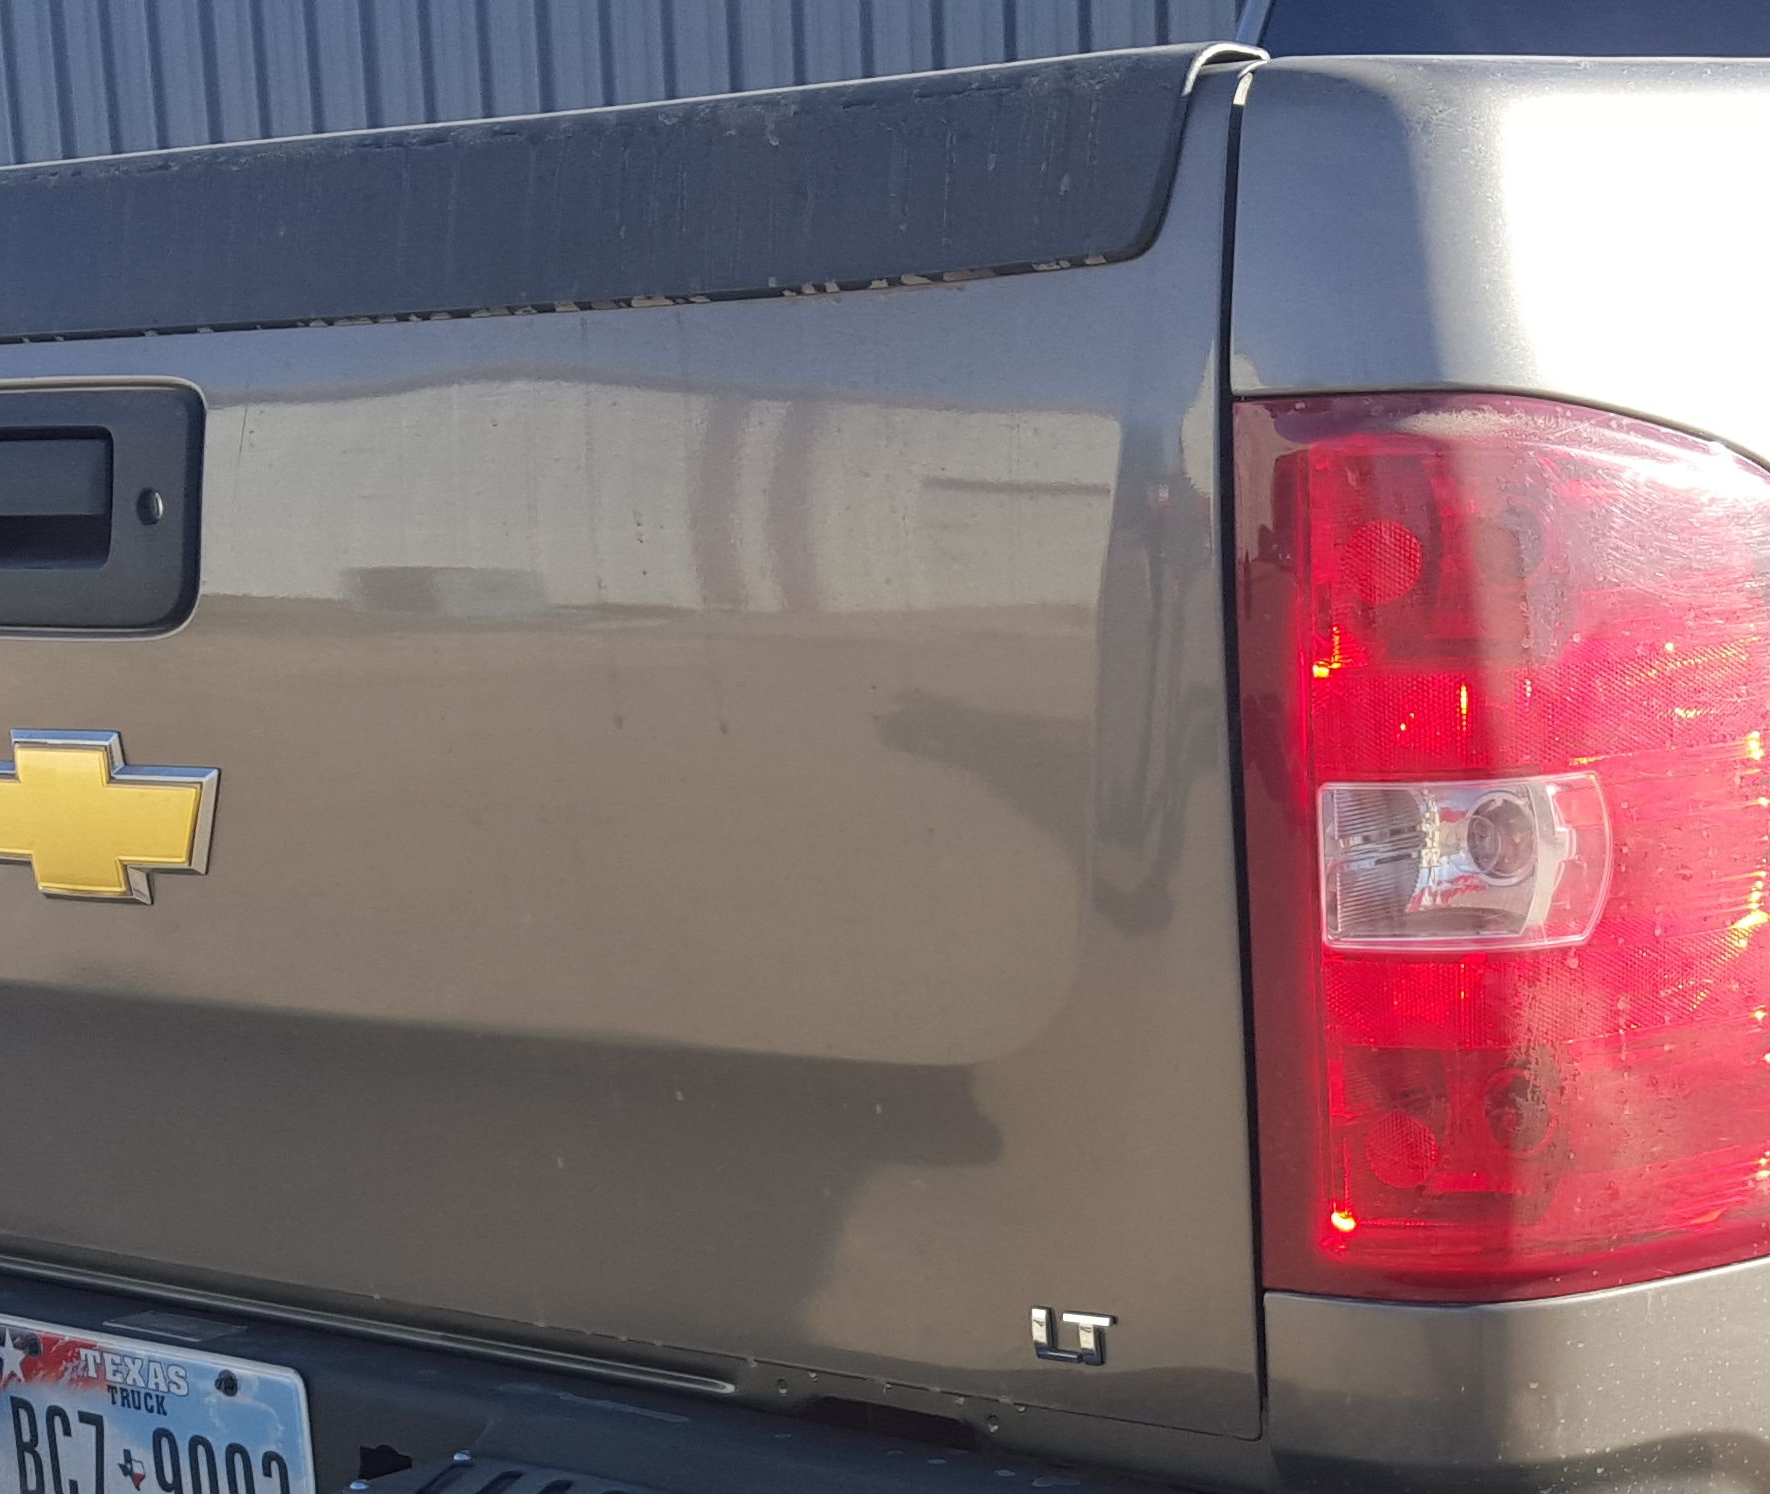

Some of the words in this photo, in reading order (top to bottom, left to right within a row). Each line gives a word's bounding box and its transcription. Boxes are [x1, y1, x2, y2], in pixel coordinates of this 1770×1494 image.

[1031, 1306, 1117, 1366] LT
[78, 1347, 189, 1398] TEXAS
[106, 1384, 168, 1417] TRUCK
